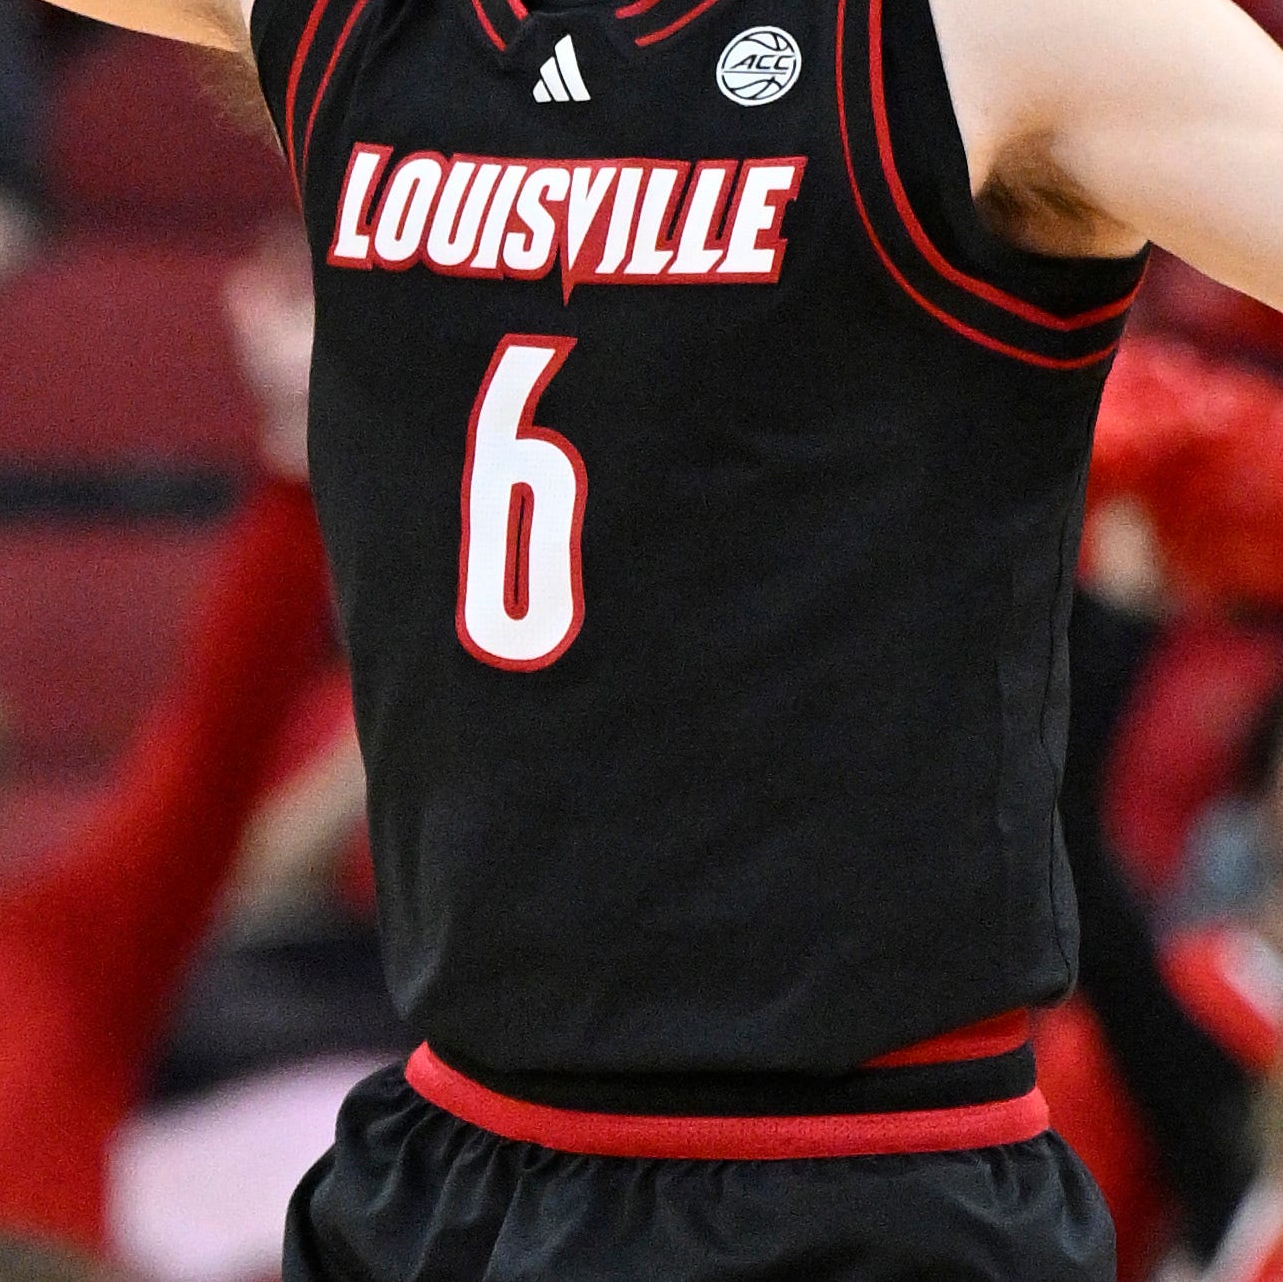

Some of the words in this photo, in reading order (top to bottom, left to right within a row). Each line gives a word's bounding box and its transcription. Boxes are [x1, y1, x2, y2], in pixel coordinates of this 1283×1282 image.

[729, 54, 795, 70] ACC
[326, 142, 808, 305] LOUISVILLE
[455, 333, 588, 672] 6
